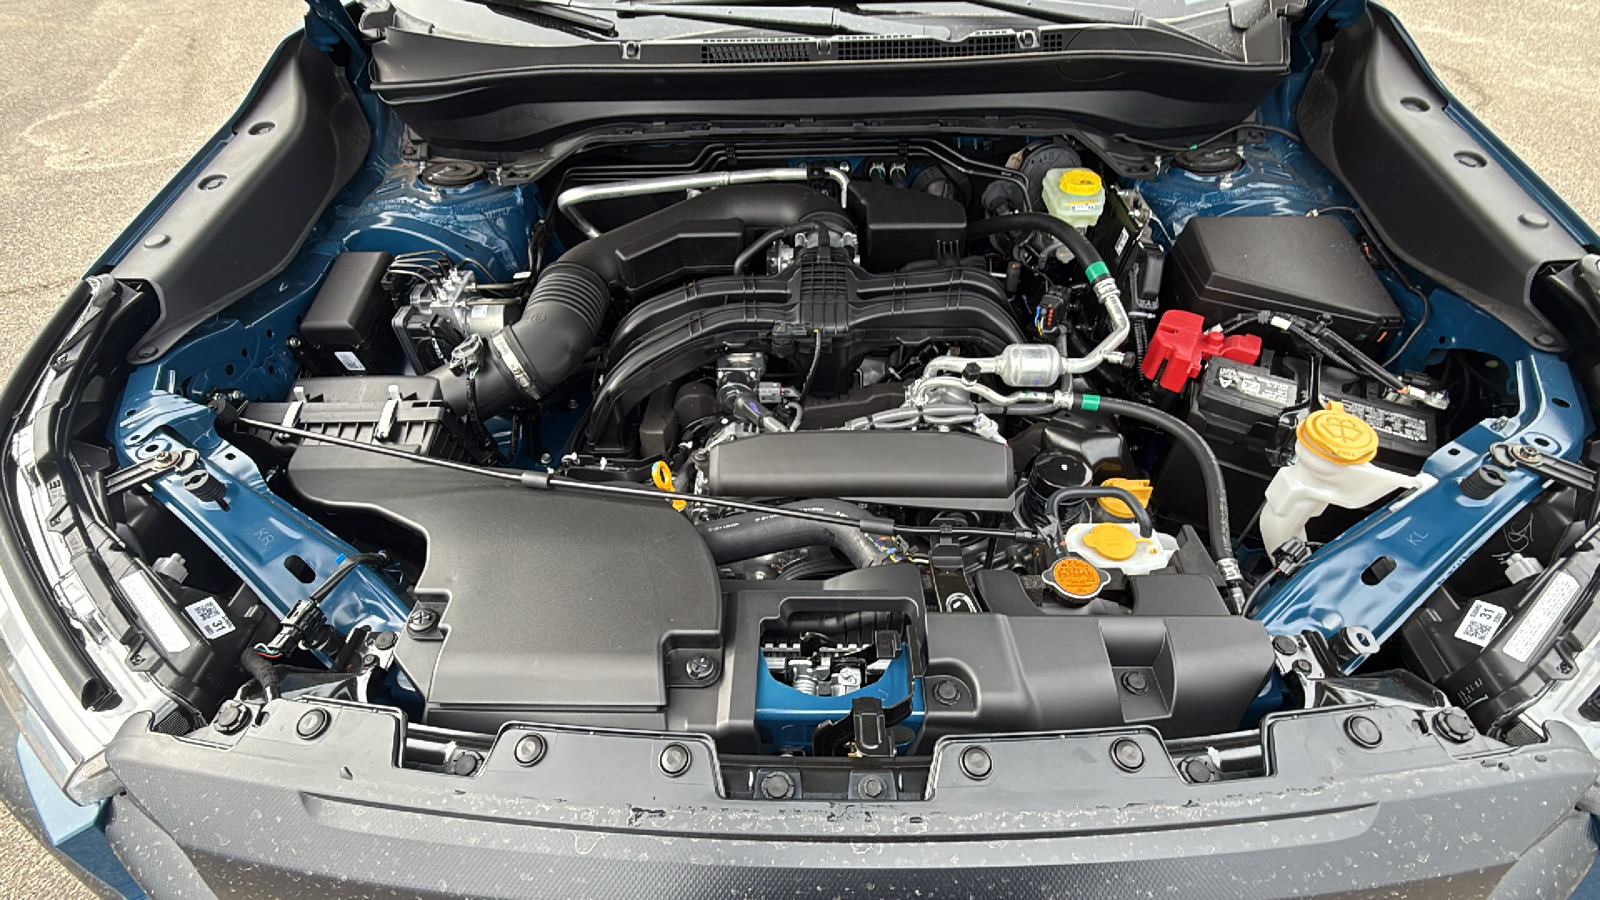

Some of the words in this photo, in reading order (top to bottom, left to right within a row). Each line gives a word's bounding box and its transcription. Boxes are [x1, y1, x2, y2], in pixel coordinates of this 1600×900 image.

[1337, 449, 1356, 457] FULL
[253, 527, 275, 546] KR
[1406, 531, 1429, 546] KL
[1479, 608, 1495, 620] 31
[211, 620, 226, 632] 31
